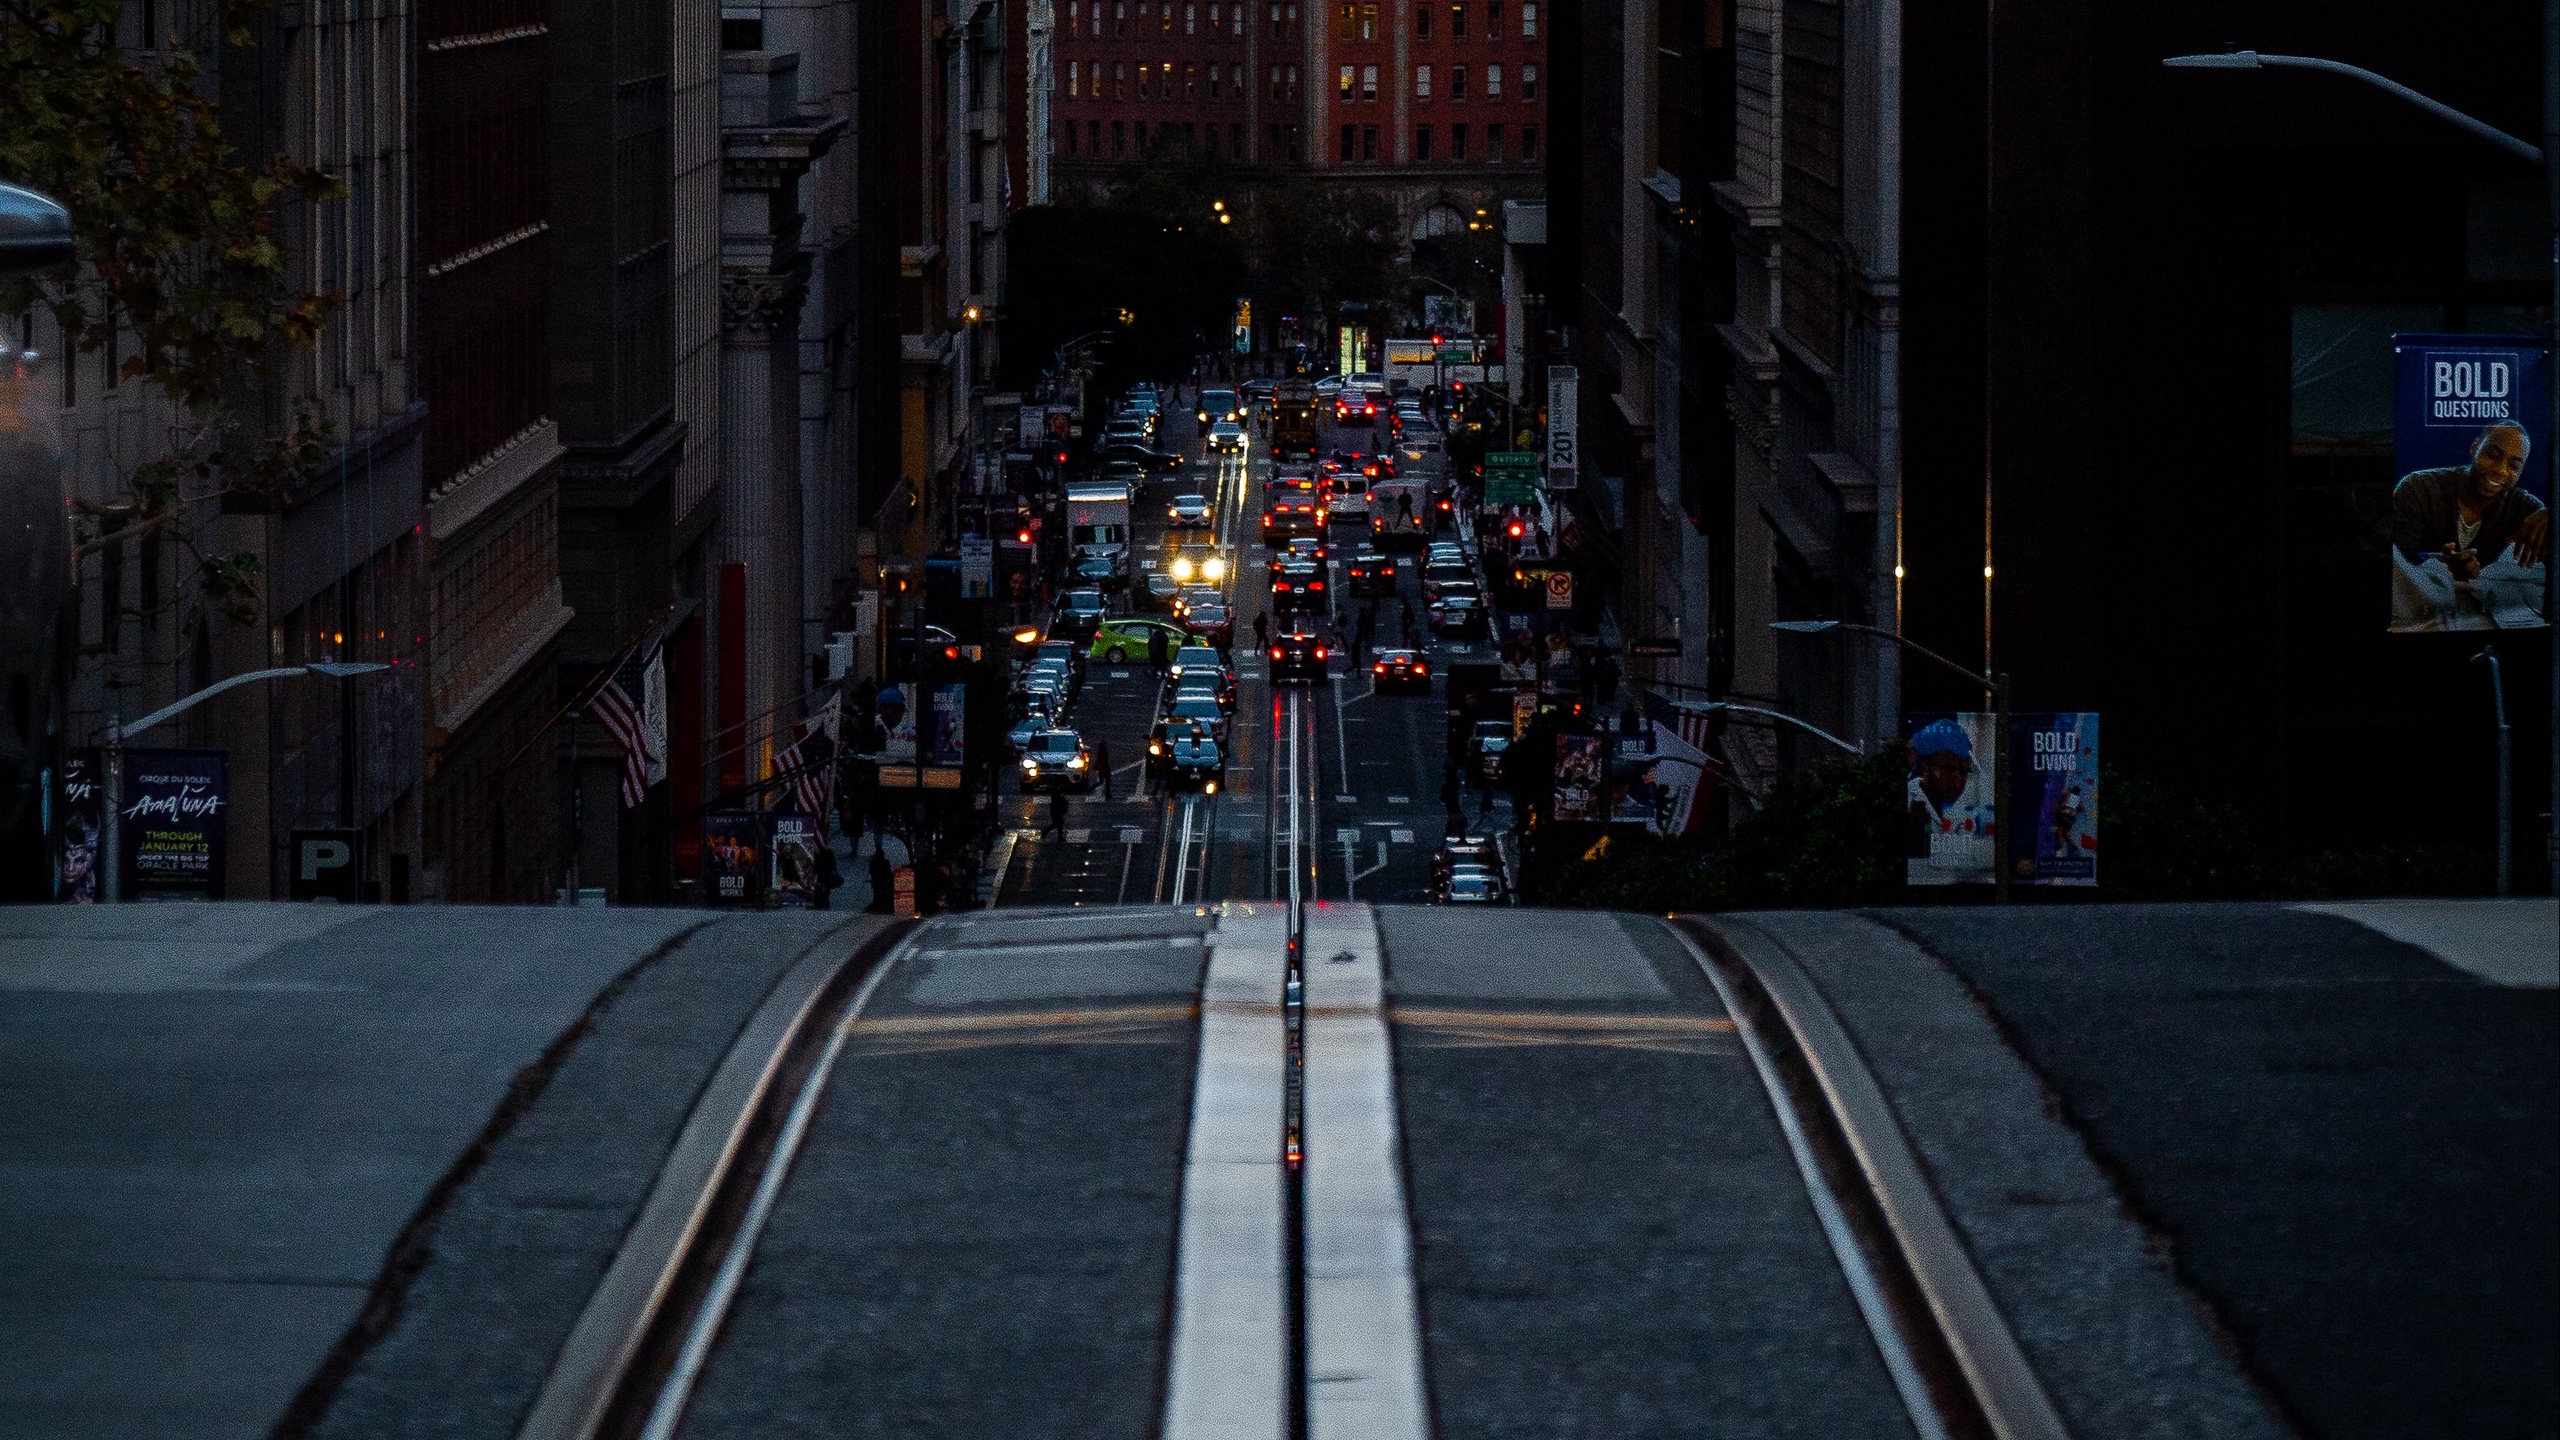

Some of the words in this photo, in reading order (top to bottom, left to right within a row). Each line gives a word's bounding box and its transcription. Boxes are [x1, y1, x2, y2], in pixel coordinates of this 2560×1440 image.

[2434, 361, 2509, 398] BOLD
[1552, 383, 1562, 430] CALIFORNIA
[2434, 400, 2509, 418] QUESTIONS
[1552, 431, 1573, 465] 201
[2034, 731, 2077, 752] BOLD
[2034, 754, 2077, 771] LIVING
[139, 775, 169, 784] CIRQUE
[171, 775, 182, 784] DU
[184, 775, 212, 784] SOLEIL
[778, 820, 803, 833] BOLD
[145, 831, 203, 841] THROUGH
[139, 842, 194, 852] JANUARY
[197, 843, 209, 853] 12
[137, 861, 179, 870] ORACLE
[182, 862, 209, 870] PARK
[301, 840, 350, 880] P
[720, 876, 745, 888] BOLD
